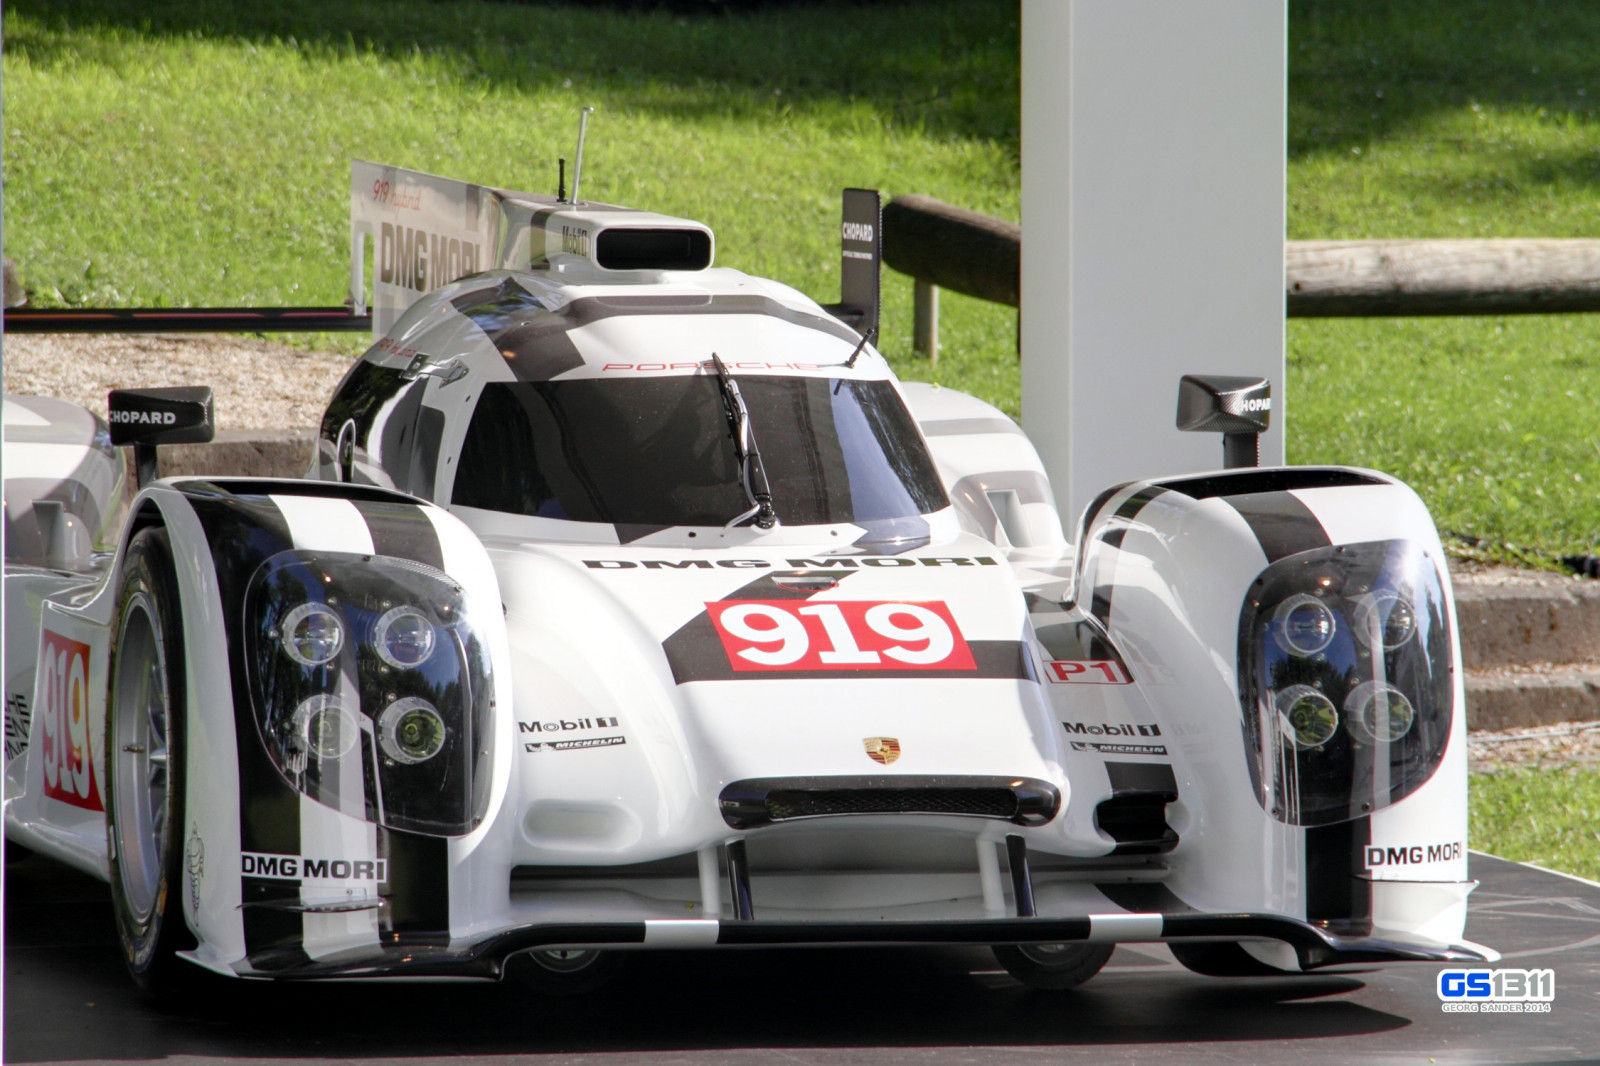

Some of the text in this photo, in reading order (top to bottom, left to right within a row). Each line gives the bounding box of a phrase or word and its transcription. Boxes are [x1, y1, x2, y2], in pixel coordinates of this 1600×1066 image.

[373, 179, 390, 204] 919
[843, 222, 873, 242] CHOPARD
[381, 221, 427, 293] DMG
[602, 362, 823, 372] PORSCHE
[582, 556, 999, 569] DMG MORI
[720, 602, 954, 666] 919
[1050, 662, 1118, 683] P1
[43, 641, 90, 800] 919
[518, 717, 619, 733] Mobil 1
[1062, 722, 1161, 736] Mobil 1
[555, 737, 623, 749] MICHELIN
[1100, 744, 1164, 753] MICHELIN
[1367, 842, 1462, 866] DMG MORI
[241, 855, 386, 880] DMG MORI
